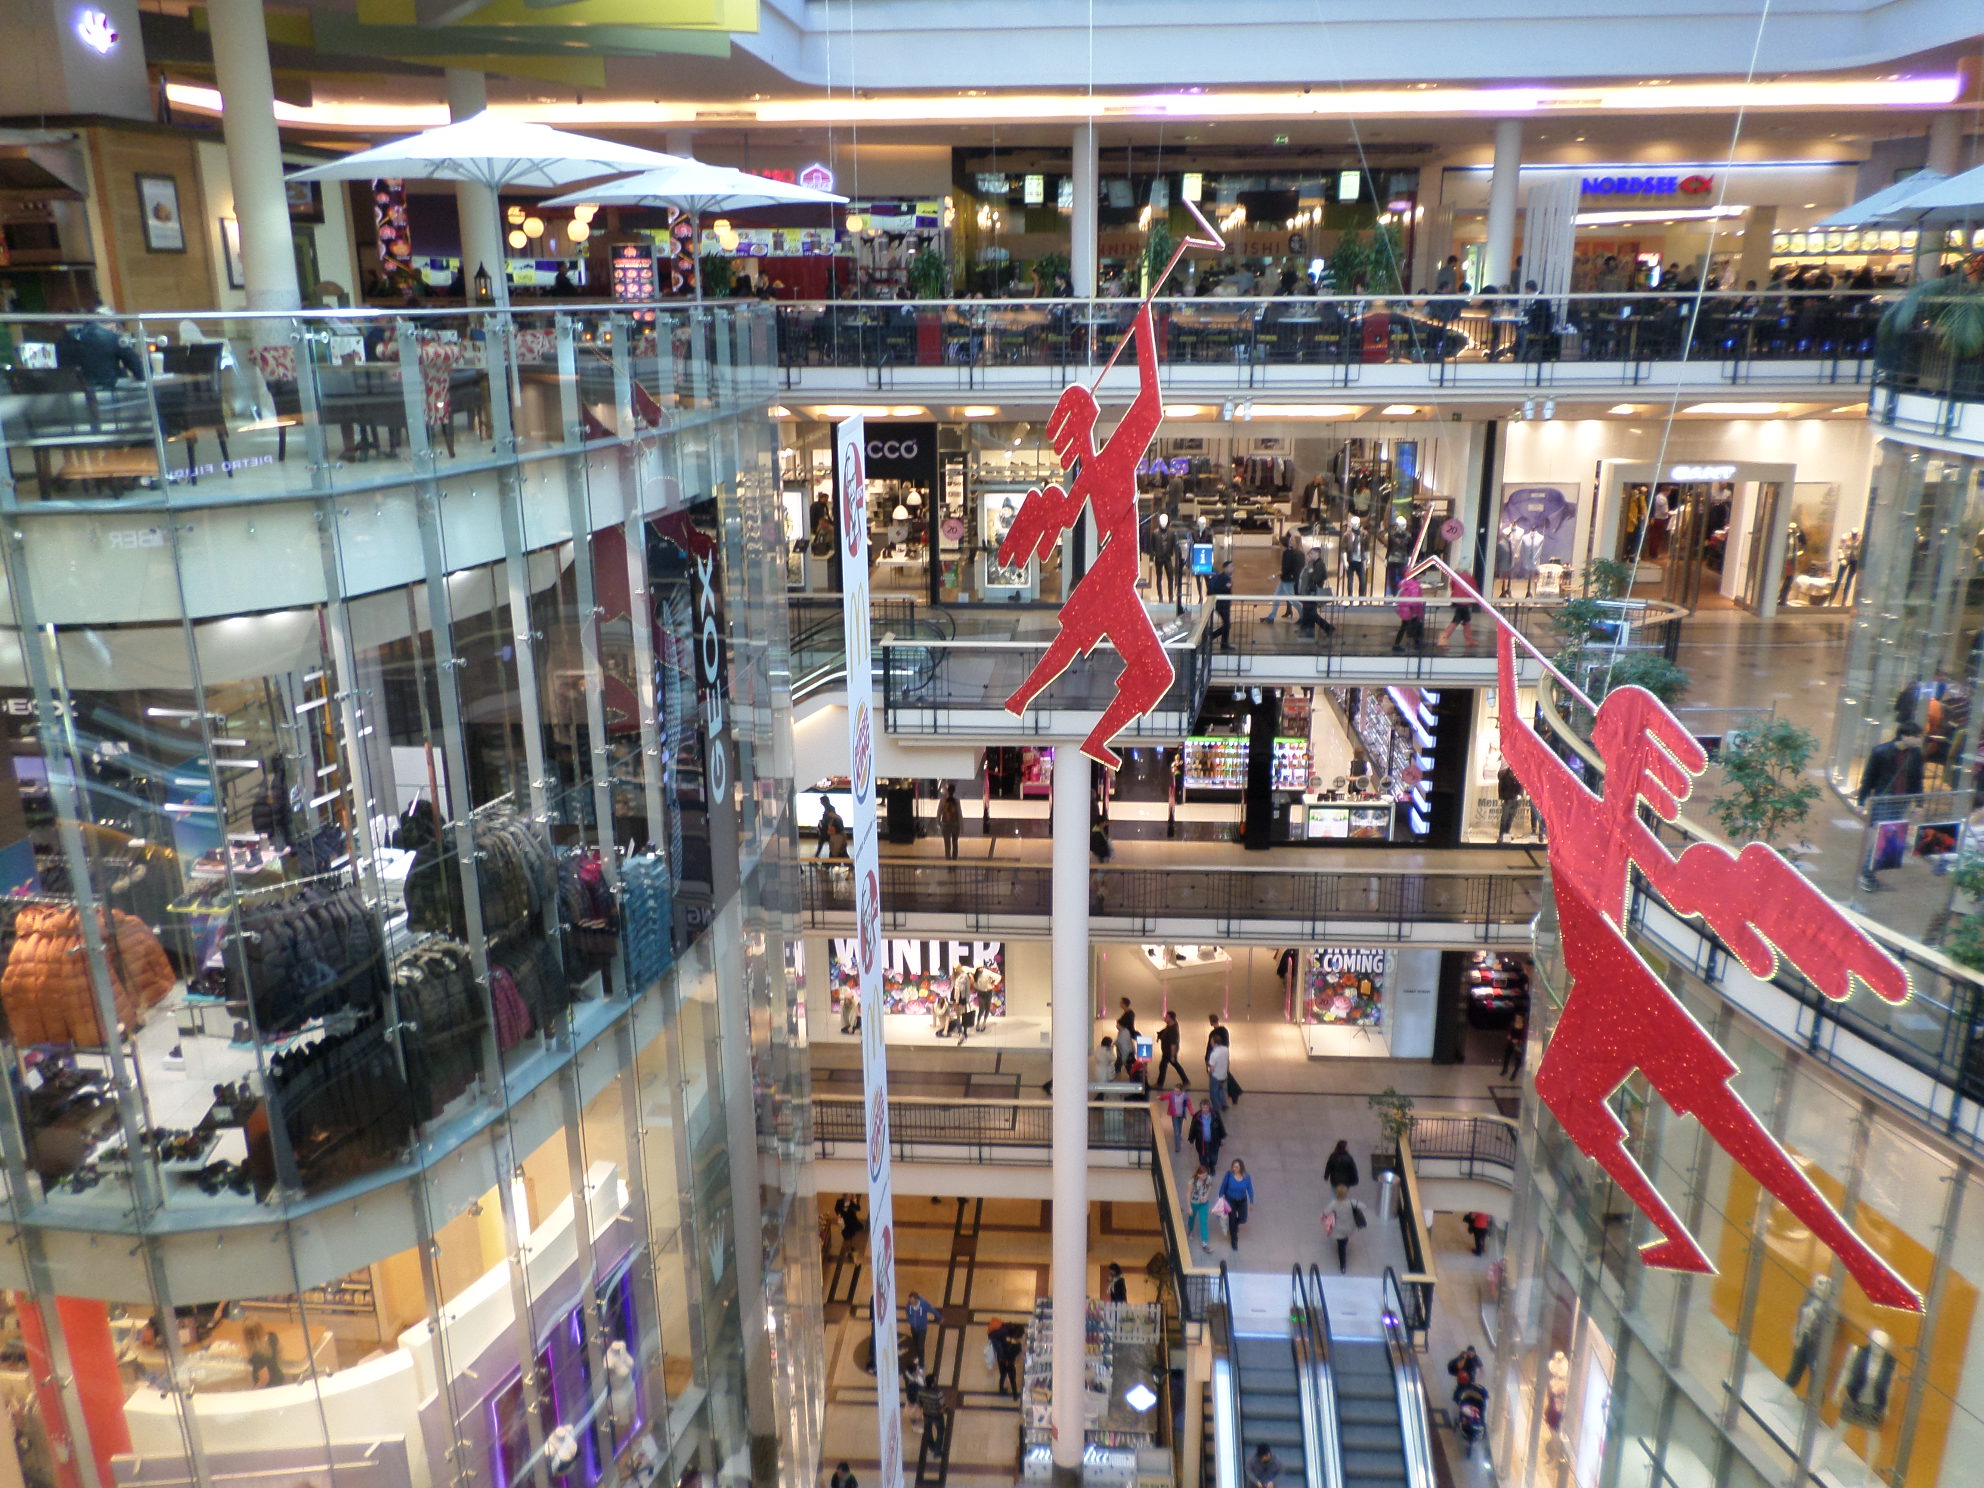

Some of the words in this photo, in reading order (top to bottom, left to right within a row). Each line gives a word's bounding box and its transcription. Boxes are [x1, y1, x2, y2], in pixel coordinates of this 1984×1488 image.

[1581, 176, 1677, 195] NORDSEE
[698, 548, 726, 804] GEOX
[1323, 954, 1384, 973] COMING
